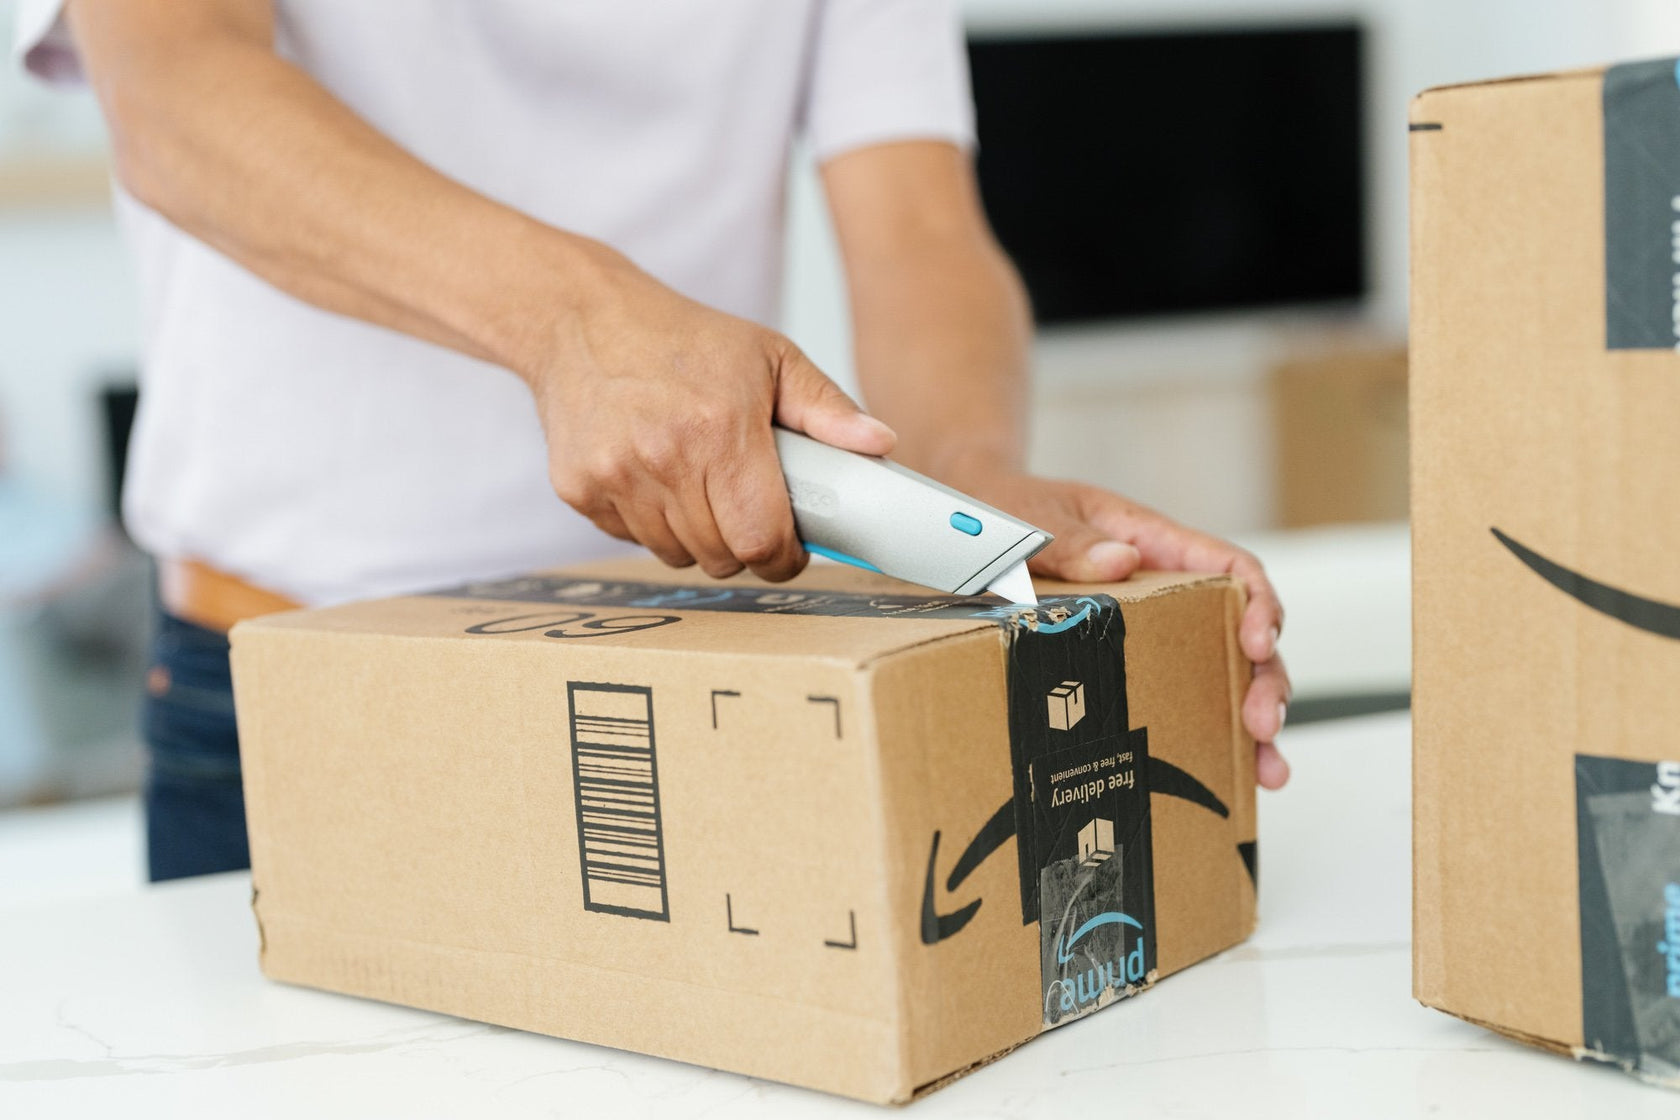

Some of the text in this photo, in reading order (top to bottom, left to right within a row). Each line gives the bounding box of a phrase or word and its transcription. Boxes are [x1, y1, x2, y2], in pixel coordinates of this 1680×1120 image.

[1050, 751, 1134, 785] fast, free & convenient
[1051, 769, 1135, 808] free delivery
[1060, 936, 1145, 1011] prime
